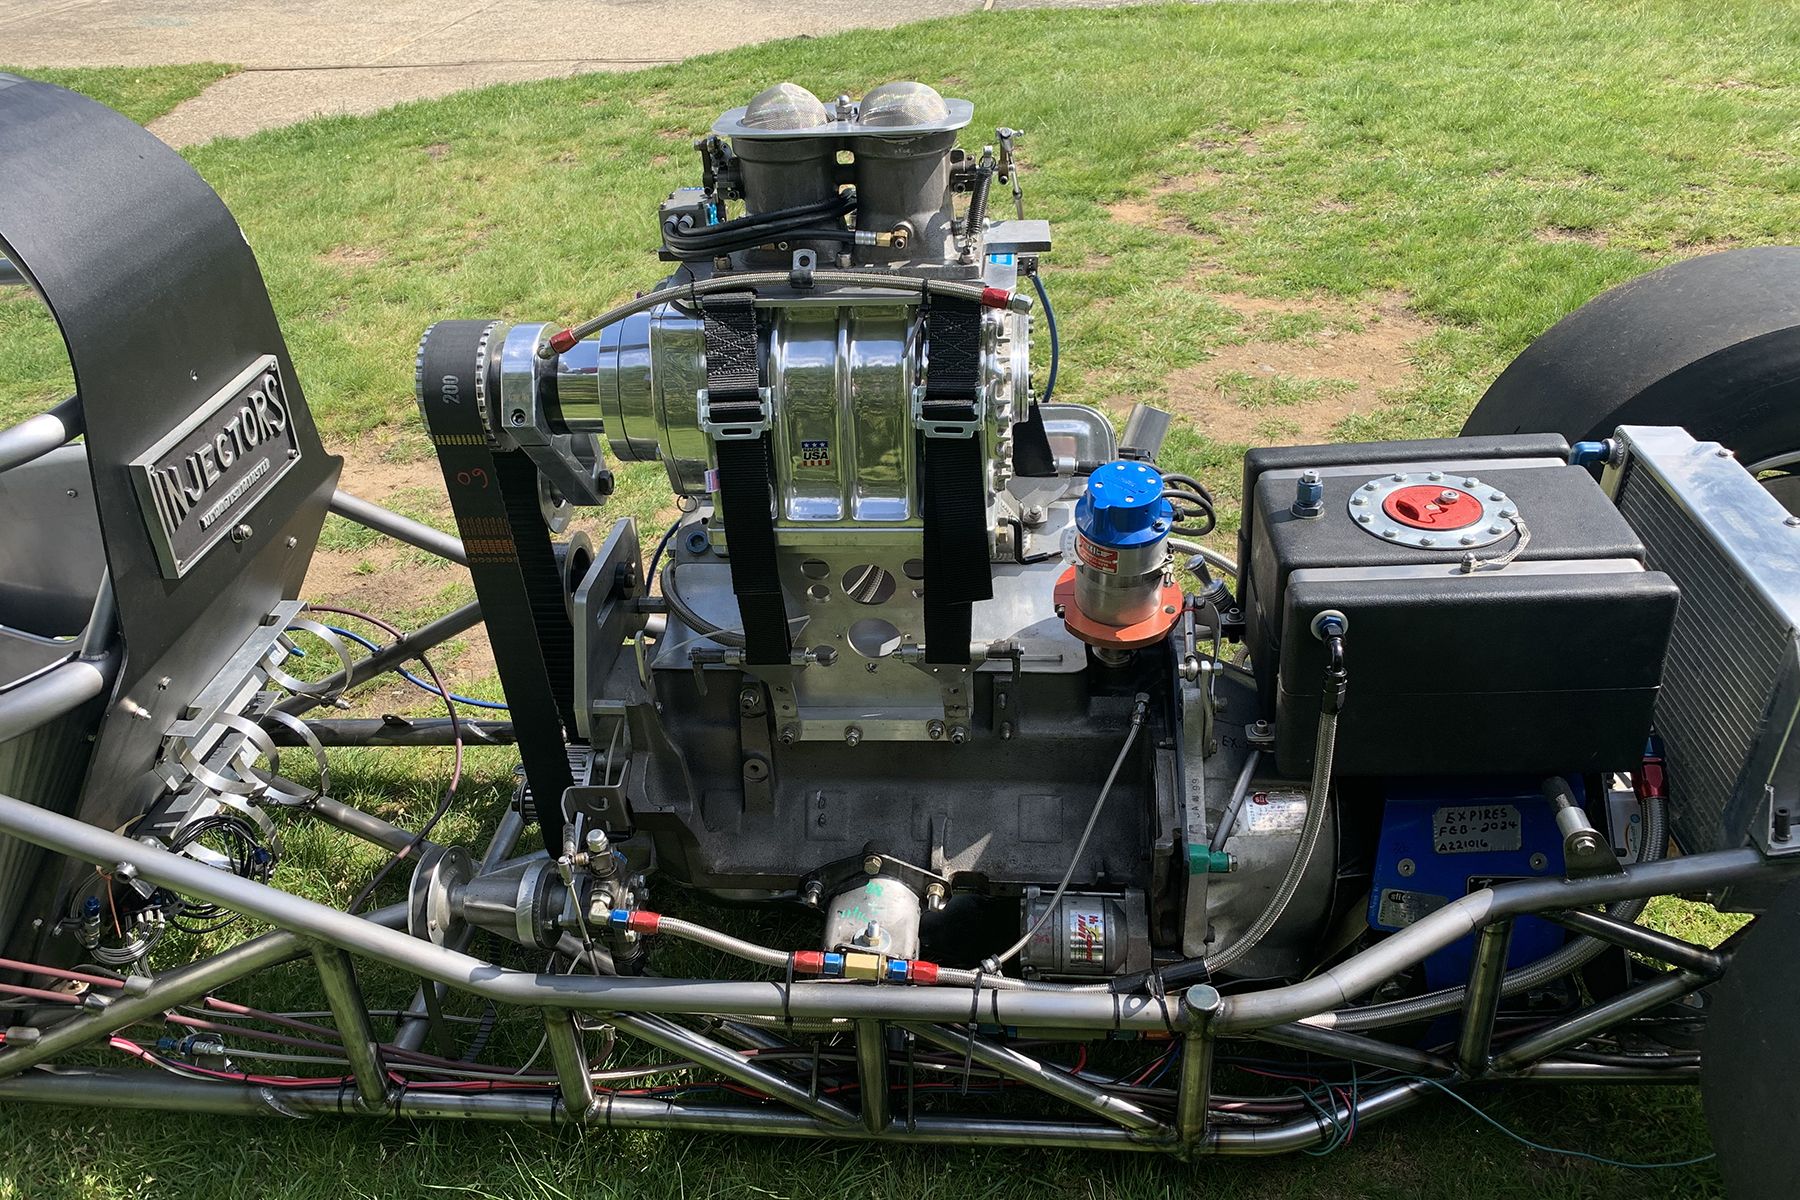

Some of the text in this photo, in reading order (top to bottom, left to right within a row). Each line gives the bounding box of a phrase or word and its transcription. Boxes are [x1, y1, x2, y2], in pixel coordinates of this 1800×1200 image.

[442, 375, 460, 404] 200
[151, 373, 286, 536] INJECTORS
[803, 452, 829, 460] USA
[1445, 807, 1508, 824] EXPIRES
[1438, 839, 1489, 852] A221016
